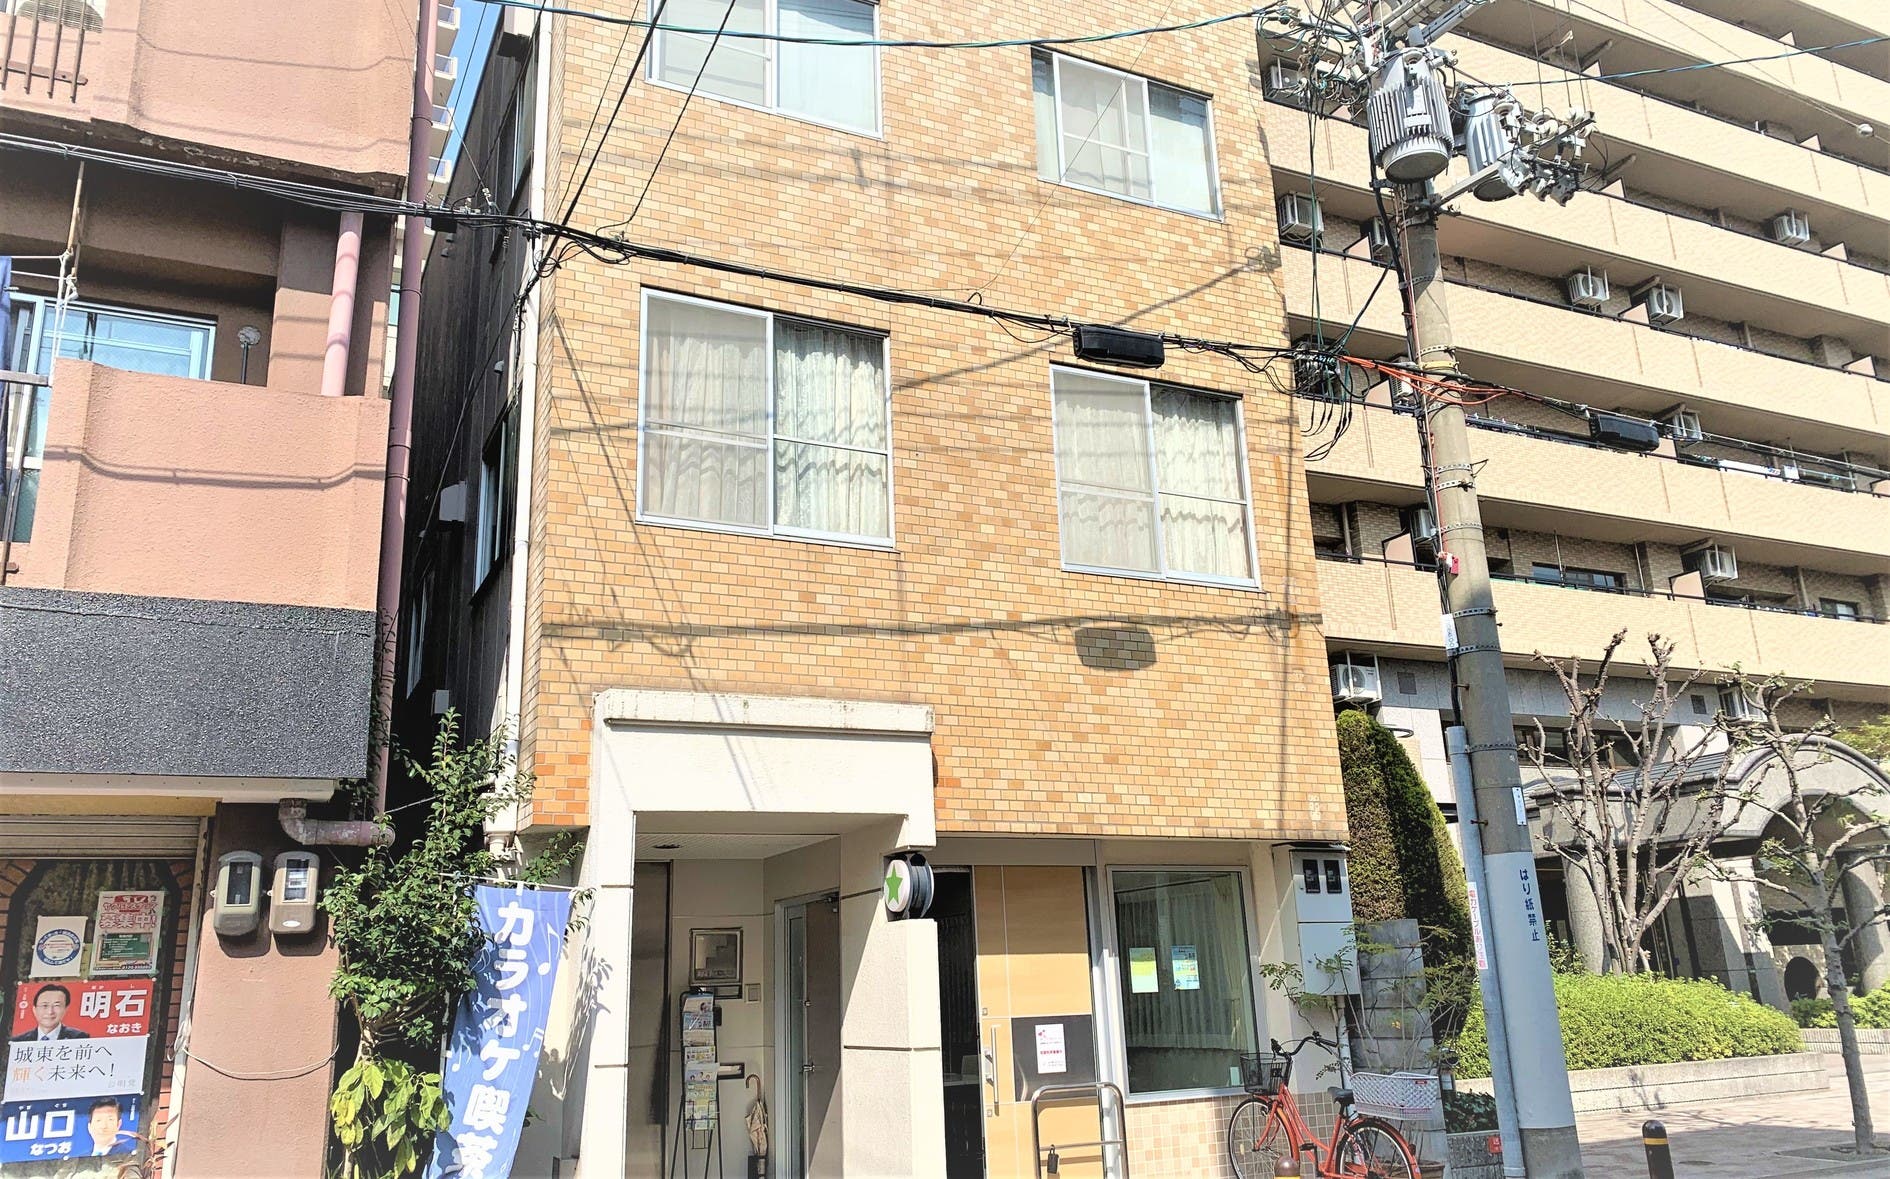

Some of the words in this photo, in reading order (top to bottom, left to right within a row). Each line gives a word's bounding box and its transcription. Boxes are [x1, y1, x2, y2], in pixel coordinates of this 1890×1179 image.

[1519, 868, 1541, 942] はり紙禁止
[80, 989, 148, 1019] 明石
[106, 1022, 142, 1034] なおき
[445, 902, 535, 1179] カラオケ喫茶
[14, 1043, 113, 1064] 城東を前へ
[12, 1063, 115, 1083] 輝く未来へ!
[5, 1109, 76, 1142] 山口
[29, 1141, 73, 1156] なつお
